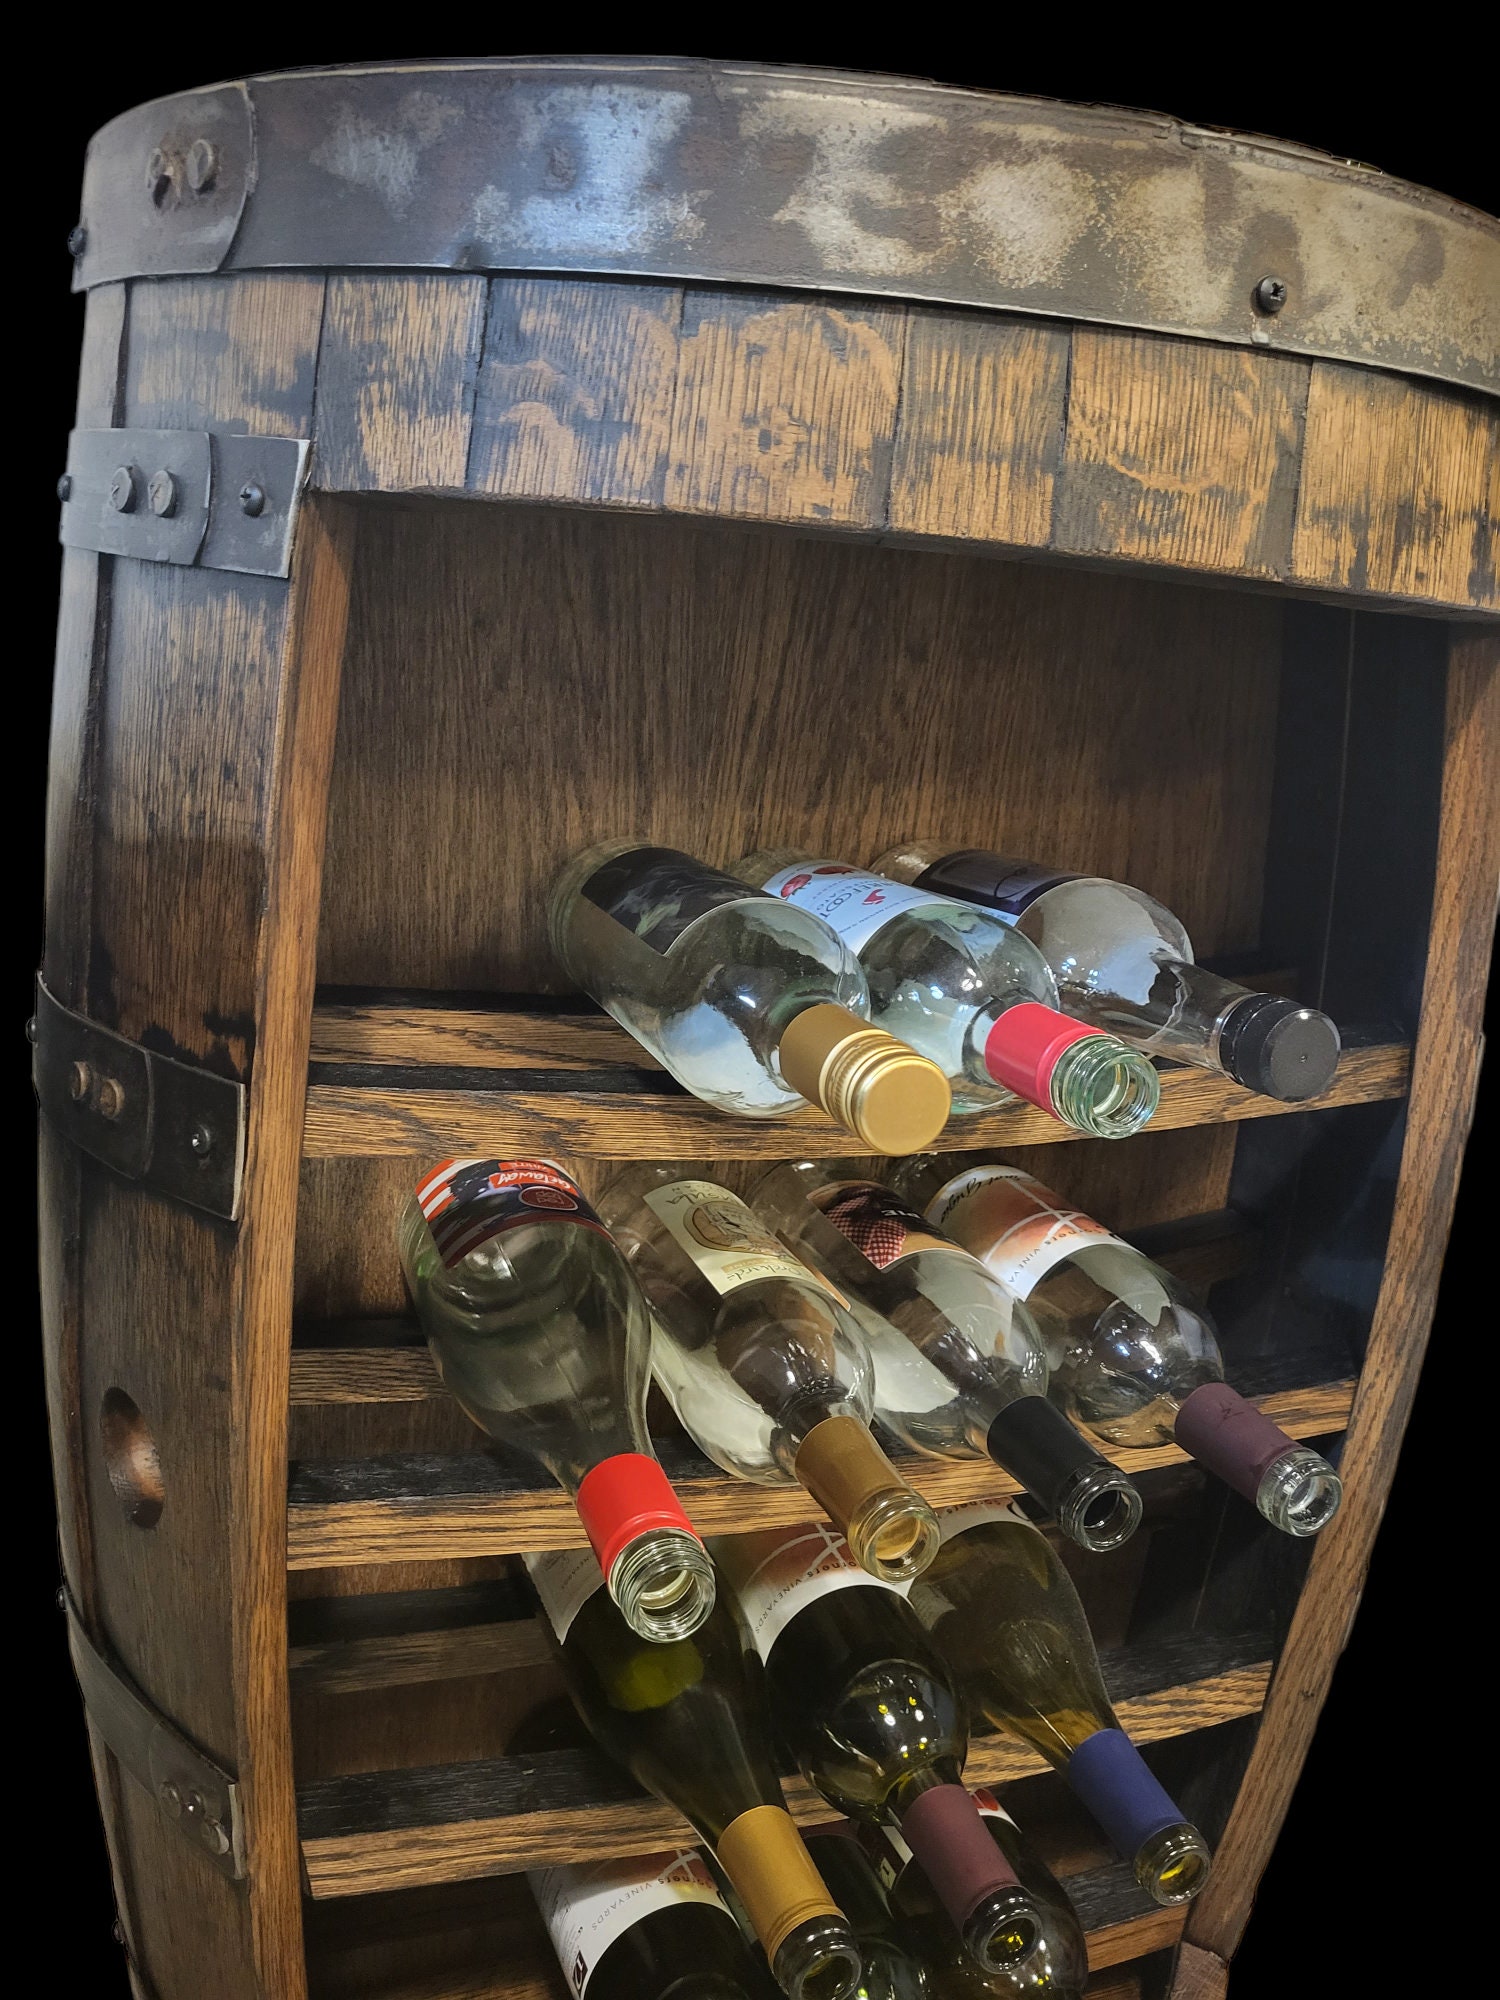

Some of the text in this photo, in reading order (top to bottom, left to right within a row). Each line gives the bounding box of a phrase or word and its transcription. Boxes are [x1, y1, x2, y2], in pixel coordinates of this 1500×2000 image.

[497, 1172, 571, 1189] Getaway
[1007, 1248, 1041, 1283] VINEYA
[755, 1561, 857, 1634] orners VINEYARDS
[591, 1882, 653, 1931] VINEYARDS
